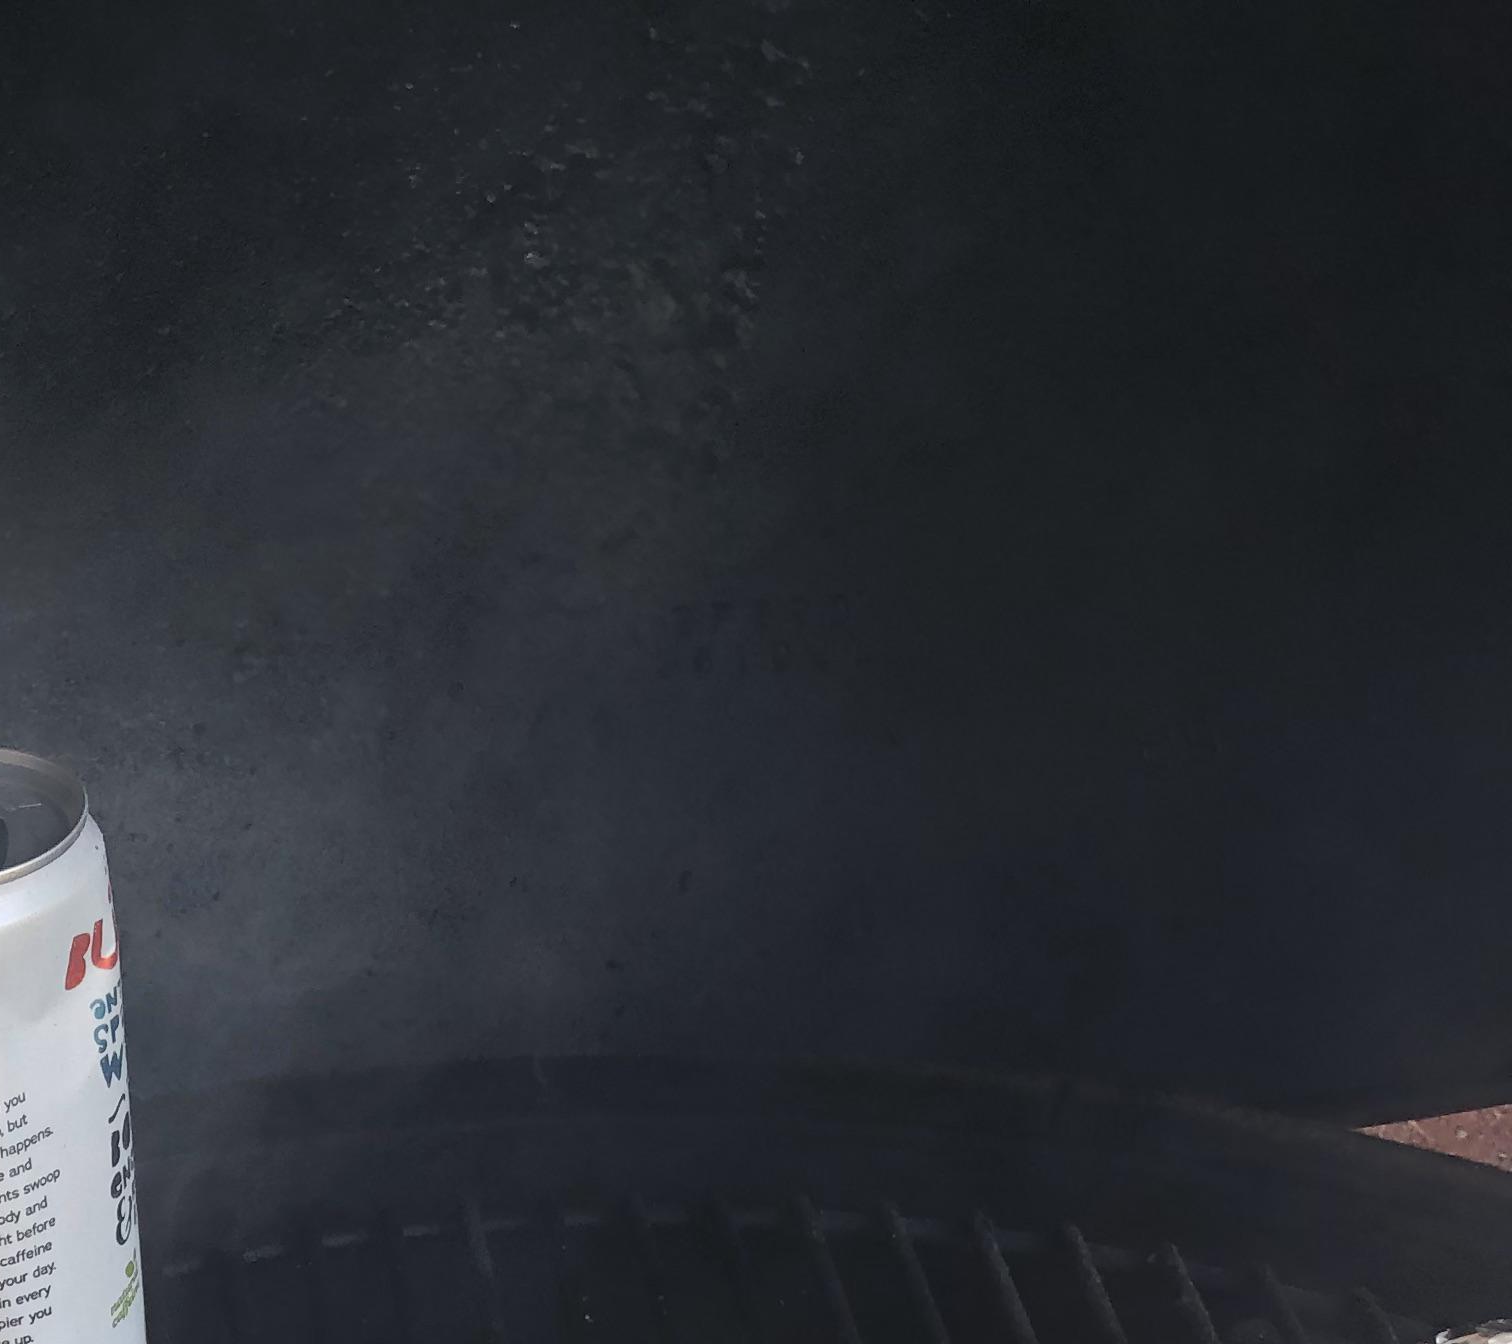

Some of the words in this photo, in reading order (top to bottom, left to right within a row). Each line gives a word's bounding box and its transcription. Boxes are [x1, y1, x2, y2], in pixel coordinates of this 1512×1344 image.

[4, 1092, 26, 1112] you
[7, 1114, 28, 1133] but
[9, 1157, 33, 1178] and
[23, 1168, 61, 1194] swoop
[26, 1195, 48, 1217] and
[17, 1216, 56, 1242] before
[0, 1241, 53, 1267] caffeine
[16, 1285, 52, 1306] every
[29, 1306, 52, 1325] you
